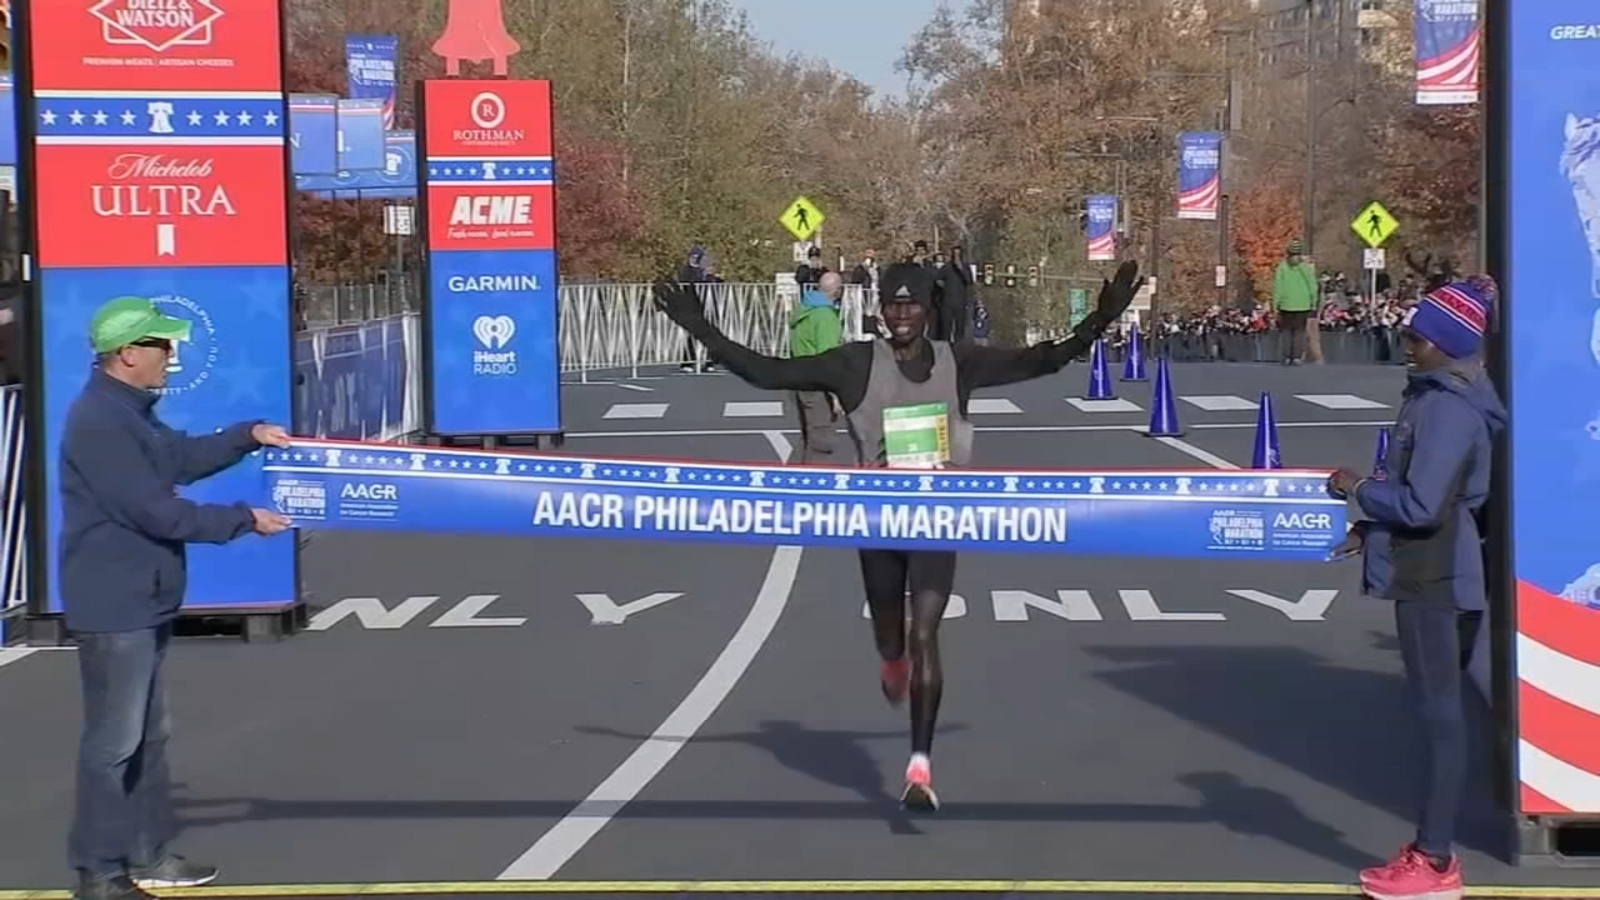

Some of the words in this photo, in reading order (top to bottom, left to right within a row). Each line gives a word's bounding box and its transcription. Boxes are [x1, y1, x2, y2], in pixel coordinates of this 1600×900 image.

[115, 9, 194, 27] WATSON
[1549, 25, 1600, 40] GREA
[482, 103, 496, 117] R
[453, 129, 525, 141] ROTHMAN
[108, 153, 214, 180] Michelob
[91, 184, 238, 217] ULTRA
[450, 195, 533, 226] ACME
[448, 274, 538, 292] GARMIN
[473, 351, 516, 363] iHeart
[473, 363, 517, 375] RADIO
[341, 483, 398, 500] AACR
[533, 491, 624, 529] AACR
[633, 495, 870, 537] PHILADELPHIA
[879, 503, 1067, 542] MARATHON
[1272, 512, 1332, 530] AACR
[304, 592, 687, 631] NLY
